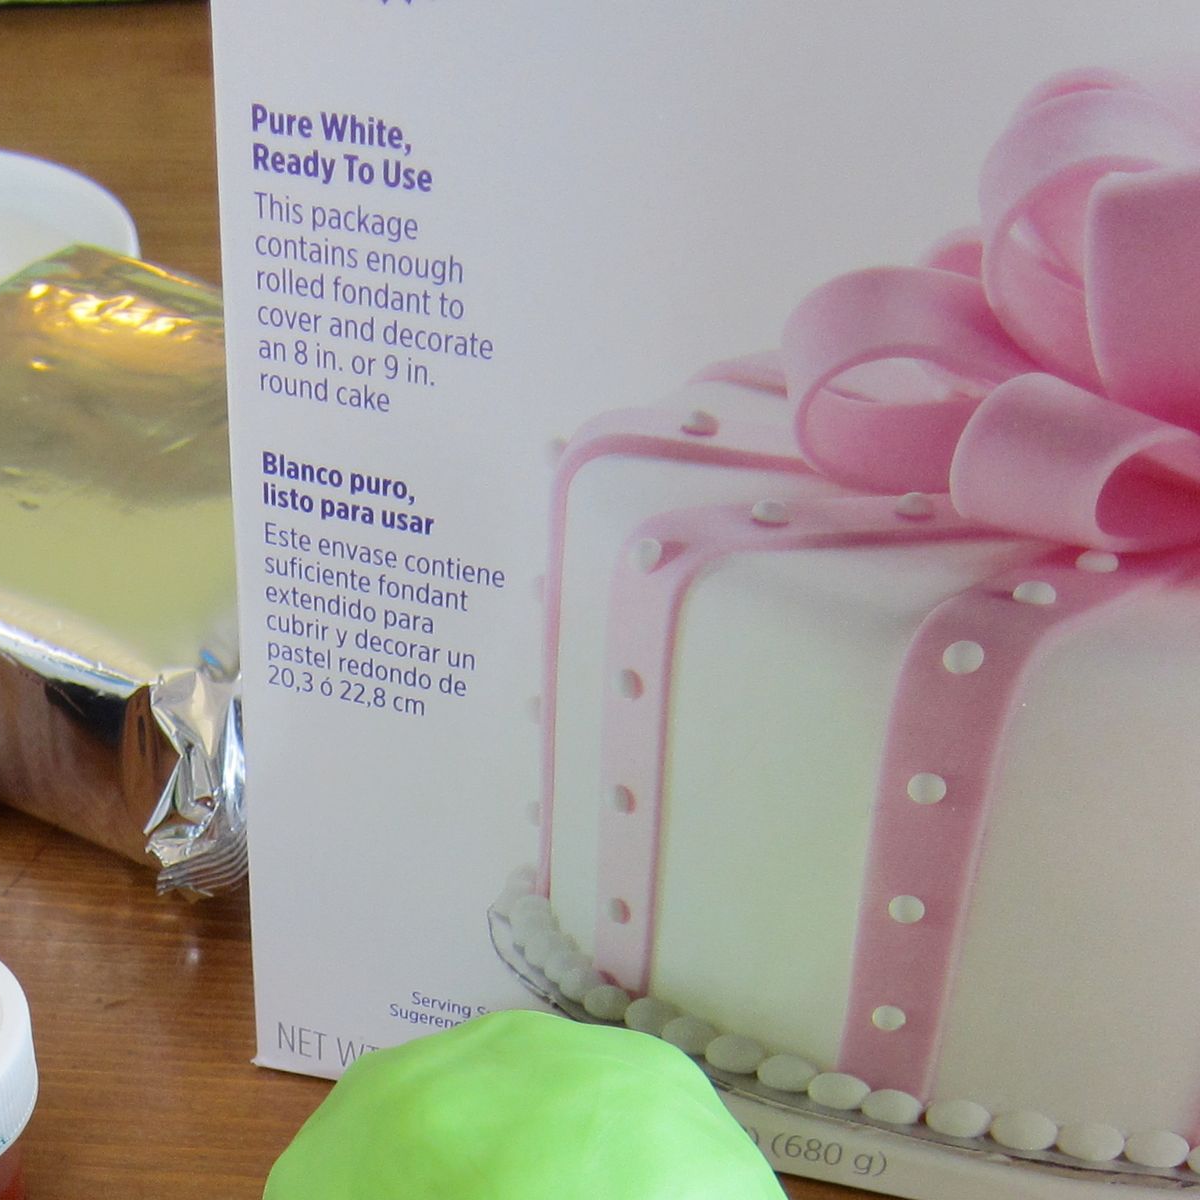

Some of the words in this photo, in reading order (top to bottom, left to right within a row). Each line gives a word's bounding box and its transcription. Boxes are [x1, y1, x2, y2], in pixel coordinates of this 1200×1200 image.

[251, 103, 313, 138] Pure
[321, 111, 412, 156] White,
[252, 143, 335, 184] Ready
[344, 153, 375, 185] To
[383, 159, 433, 192] Use
[254, 191, 303, 224] This
[311, 204, 419, 243] package
[255, 233, 358, 269] contains
[366, 250, 463, 286] enough
[256, 267, 324, 299] rolled
[333, 276, 431, 316] fondant
[439, 292, 464, 320] to
[257, 304, 322, 333] cover
[330, 316, 374, 342] and
[383, 320, 494, 360] decorate
[259, 338, 286, 362] an
[294, 341, 308, 365] 8
[315, 343, 344, 372] in.
[351, 352, 377, 376] or
[384, 354, 399, 380] 9
[407, 358, 435, 387] in.
[259, 371, 328, 402] round
[336, 383, 390, 413] cake
[262, 451, 343, 488] Blanco
[350, 472, 416, 505] puro,
[263, 482, 314, 513] listo
[320, 499, 374, 526] para
[381, 510, 435, 535] usar
[264, 522, 311, 551] Este
[319, 538, 397, 568] envase
[404, 554, 505, 588] contiene
[265, 556, 371, 593] suficiente
[377, 574, 468, 612] fondant
[265, 584, 377, 622] extendido
[384, 607, 434, 635] para
[266, 612, 329, 642] cubrir
[336, 626, 348, 648] y
[355, 629, 441, 665] decorar
[448, 648, 476, 672] un
[267, 641, 331, 670] pastel
[338, 657, 432, 690] redondo
[439, 674, 467, 697] de
[268, 665, 314, 694] 20,3
[320, 677, 334, 697] ó
[339, 680, 387, 709] 22,8
[393, 696, 426, 717] cm
[389, 1003, 467, 1029] Sugeren
[411, 991, 472, 1019] Serving
[277, 1021, 327, 1061] NET
[337, 1037, 380, 1067] W
[771, 1132, 843, 1166] (680
[852, 1151, 887, 1177] g)
